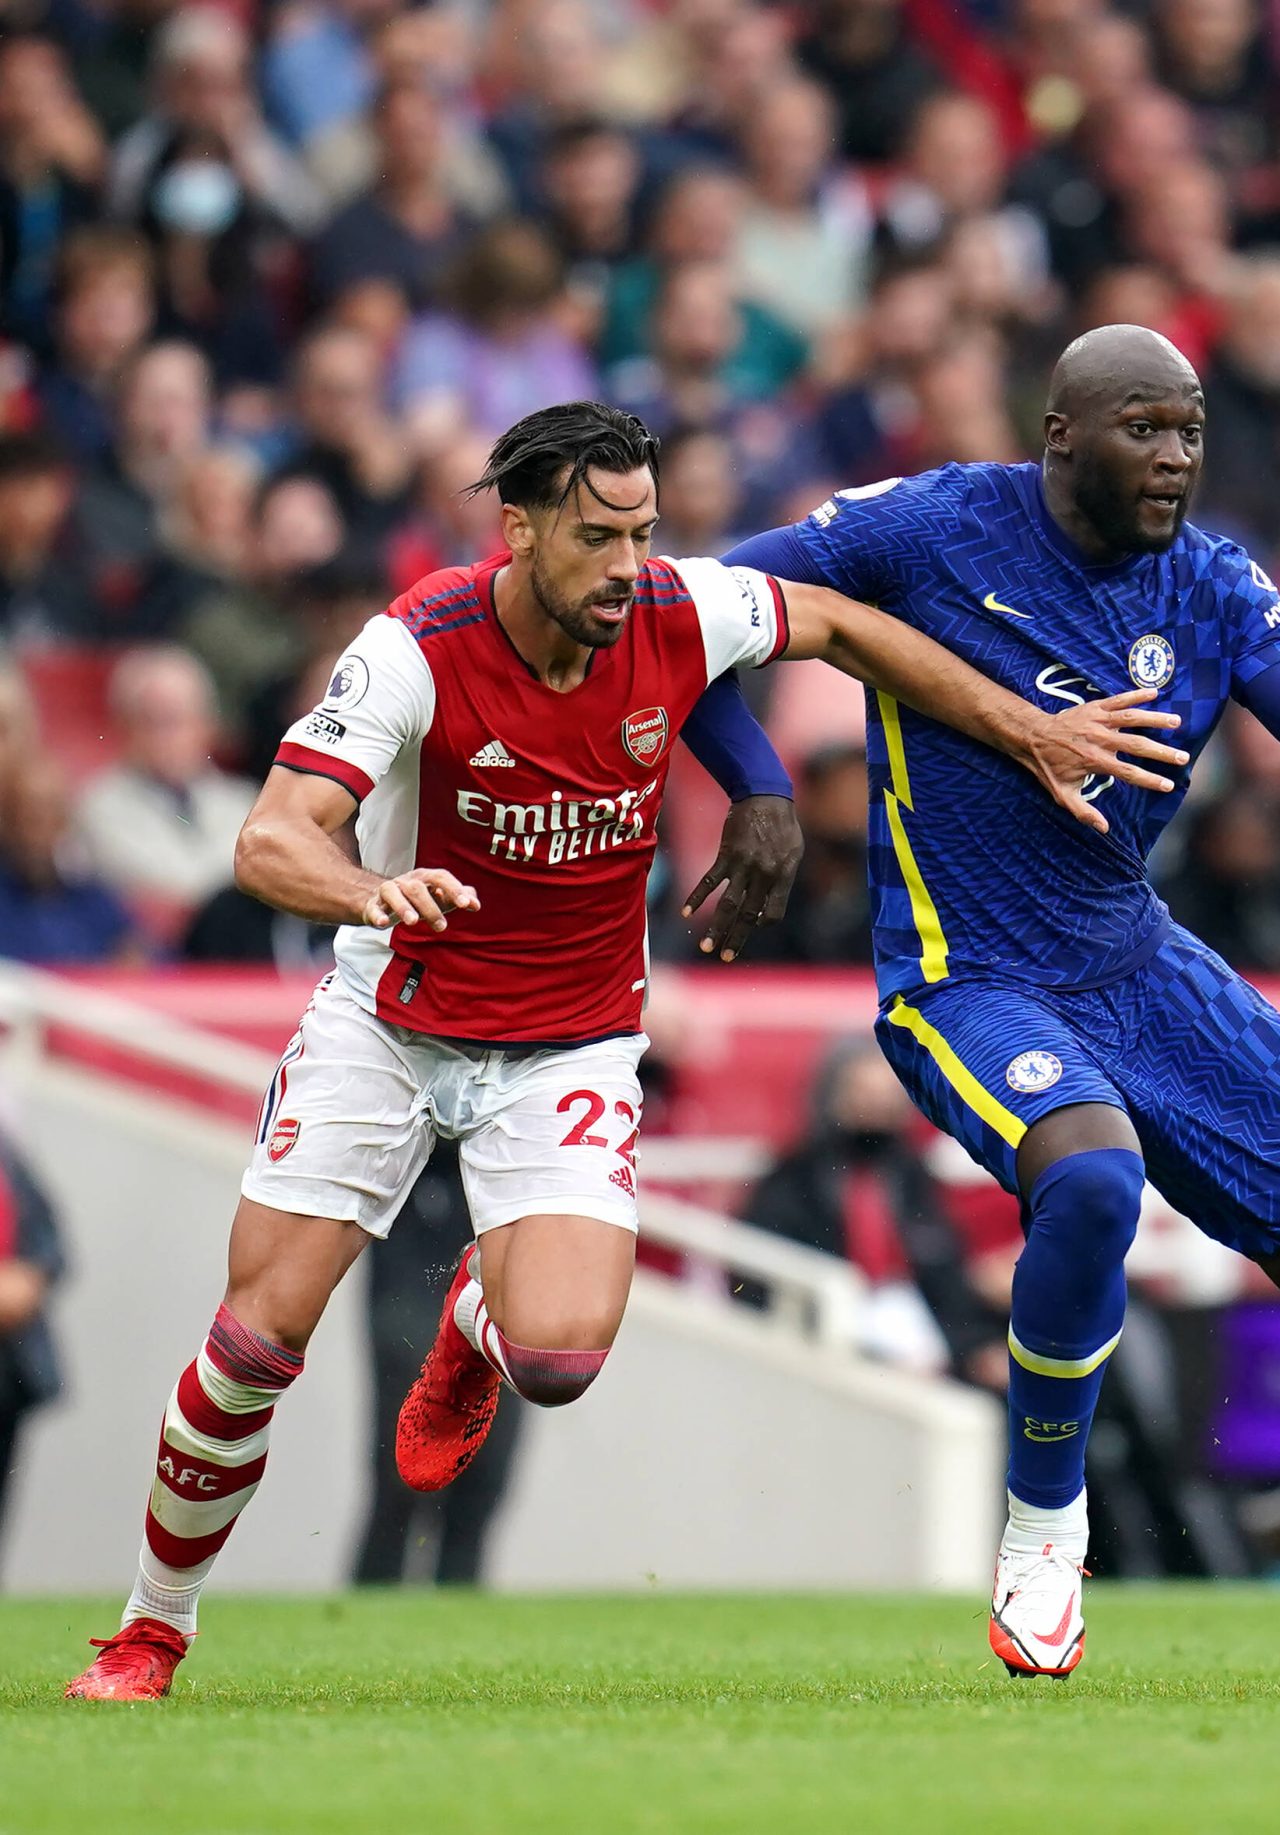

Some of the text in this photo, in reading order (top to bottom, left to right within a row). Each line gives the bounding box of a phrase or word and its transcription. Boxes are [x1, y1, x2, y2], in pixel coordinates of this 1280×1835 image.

[628, 714, 662, 736] Arsenal
[469, 755, 516, 768] adidas
[456, 778, 658, 834] Emirat
[489, 811, 644, 865] FLY BETTER
[557, 1089, 640, 1170] 22
[1024, 1416, 1080, 1433] CFC
[159, 1456, 220, 1491] AFC
